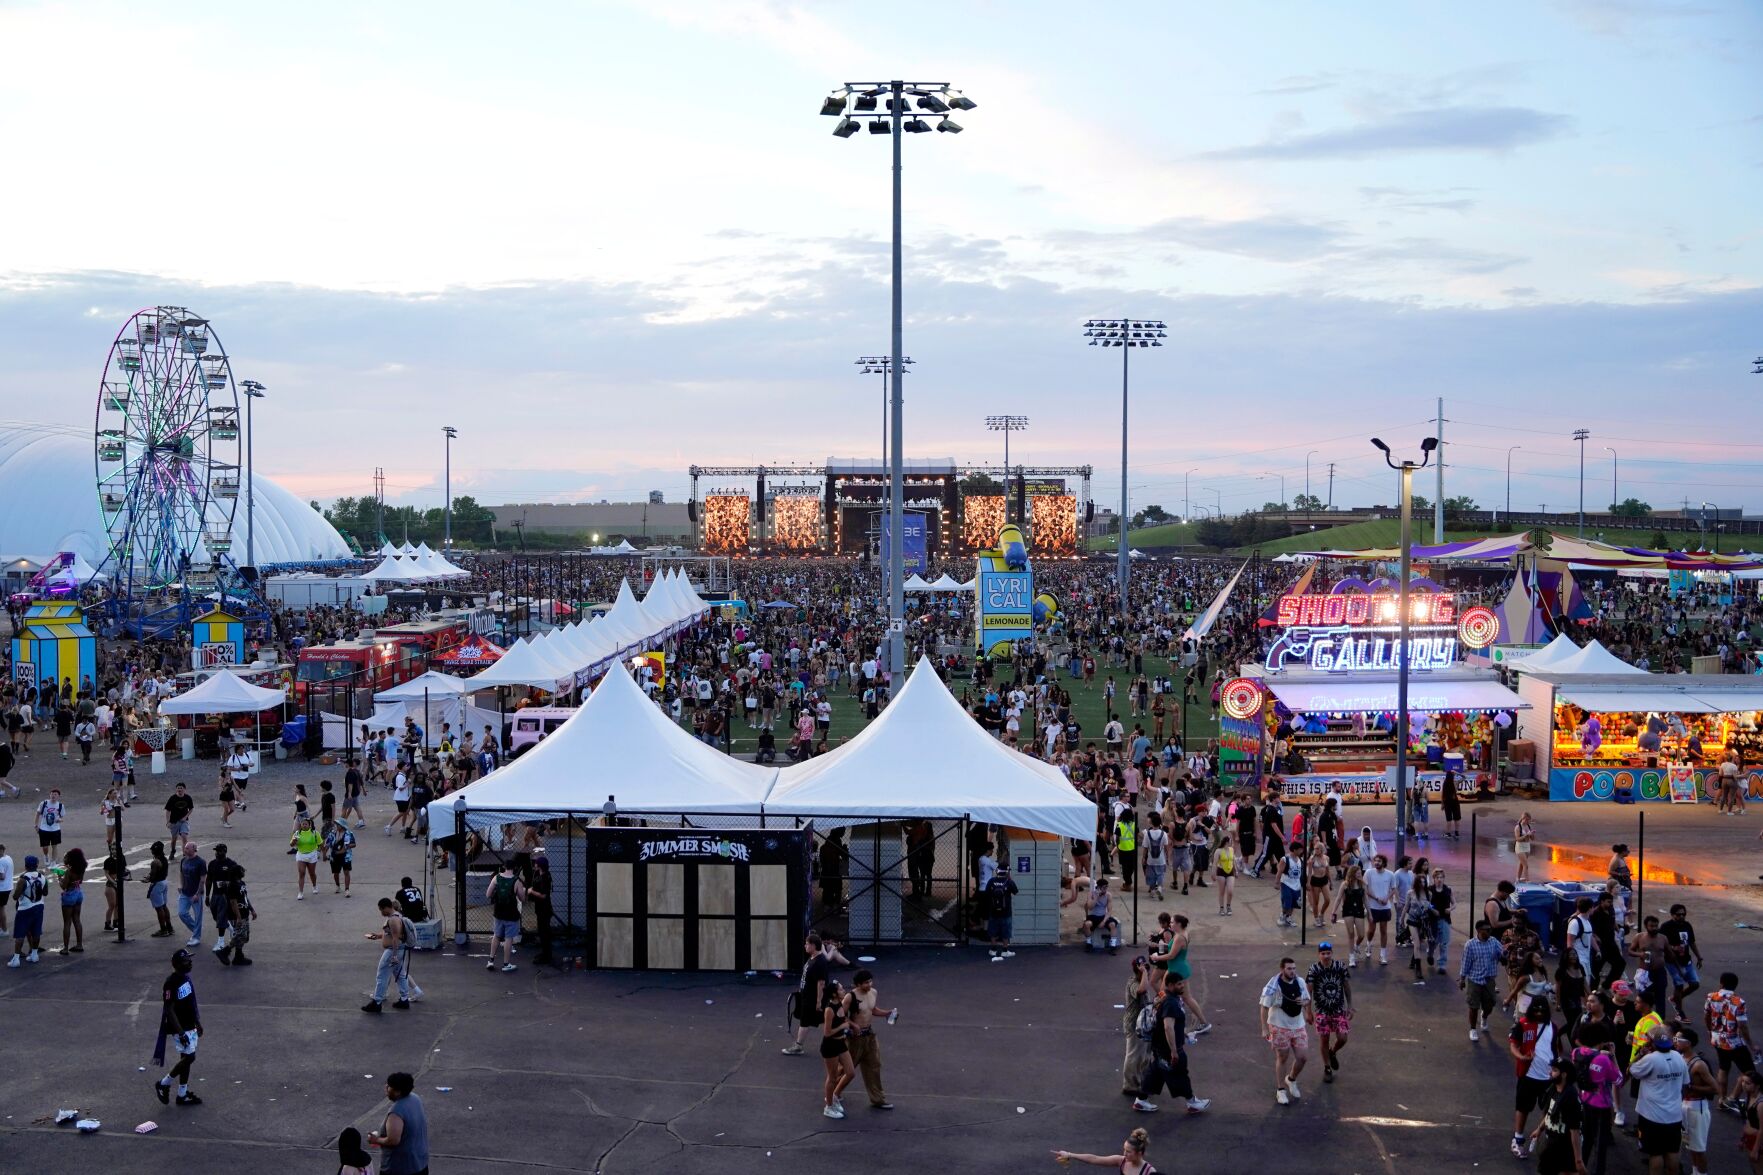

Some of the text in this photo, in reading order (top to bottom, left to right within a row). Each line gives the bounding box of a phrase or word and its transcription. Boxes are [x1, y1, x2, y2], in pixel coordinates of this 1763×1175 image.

[988, 578, 1027, 593] LYRI
[989, 593, 1027, 608] CAL
[17, 665, 34, 678] 100%
[1280, 782, 1306, 795] THIS
[1309, 782, 1321, 794] IS
[1324, 781, 1352, 795] HW
[1354, 781, 1375, 794] THE
[1574, 771, 1635, 798] POP
[639, 839, 699, 861] SUMMER
[406, 891, 422, 902] 34
